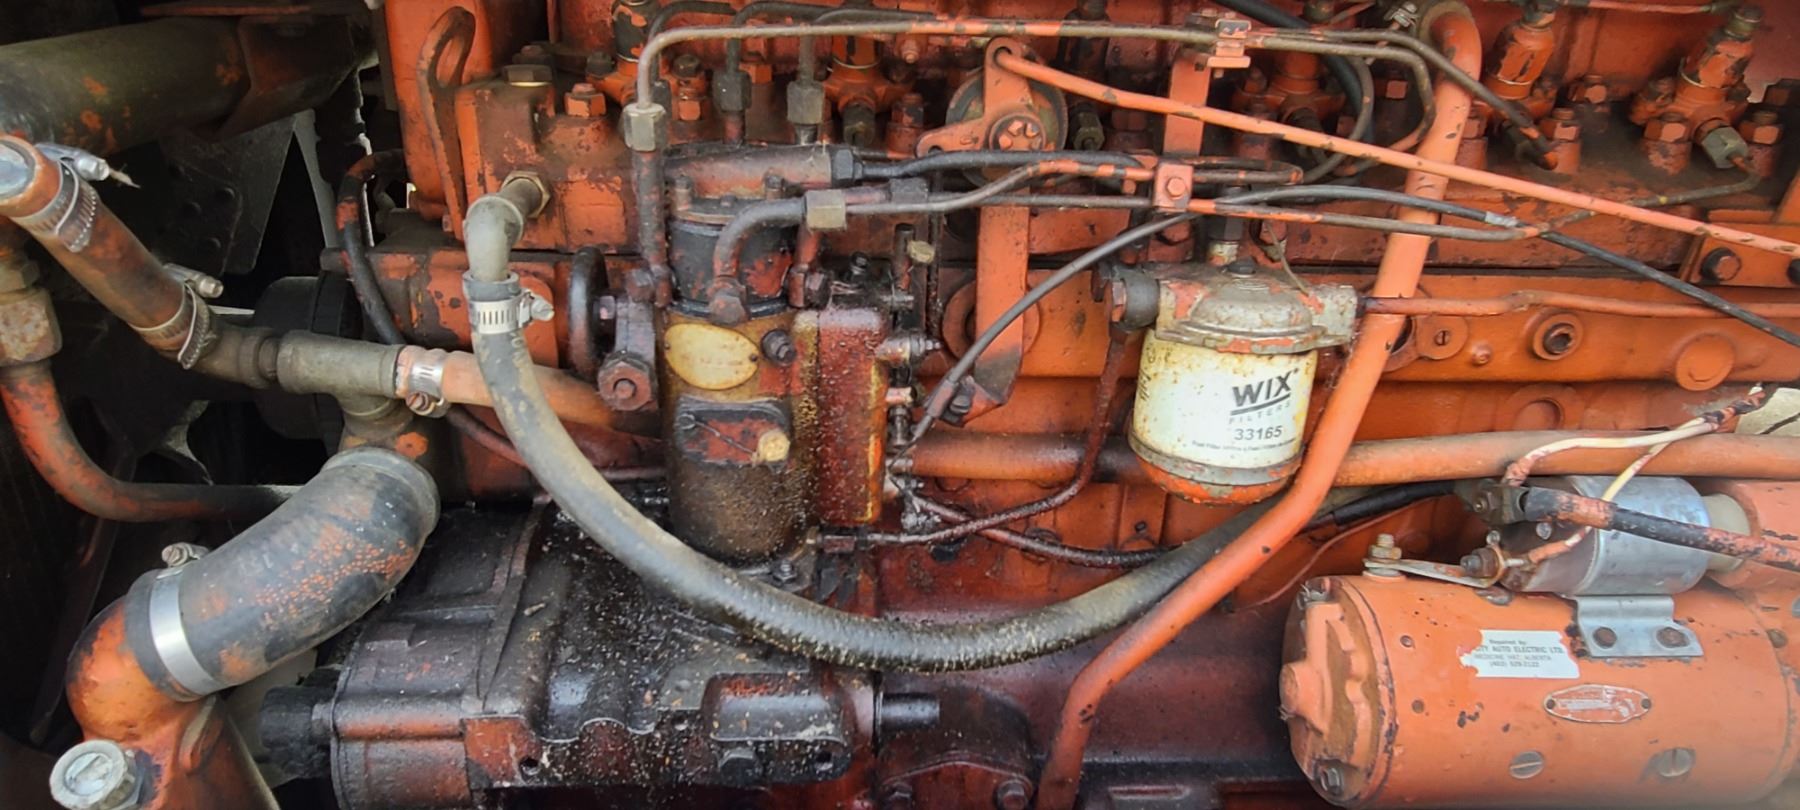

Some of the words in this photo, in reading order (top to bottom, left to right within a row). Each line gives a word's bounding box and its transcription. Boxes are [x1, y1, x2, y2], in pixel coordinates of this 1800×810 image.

[1231, 369, 1292, 407] WIX
[1228, 400, 1291, 425] FILTERS
[1234, 425, 1284, 441] 33165
[1492, 645, 1512, 653] AUTO
